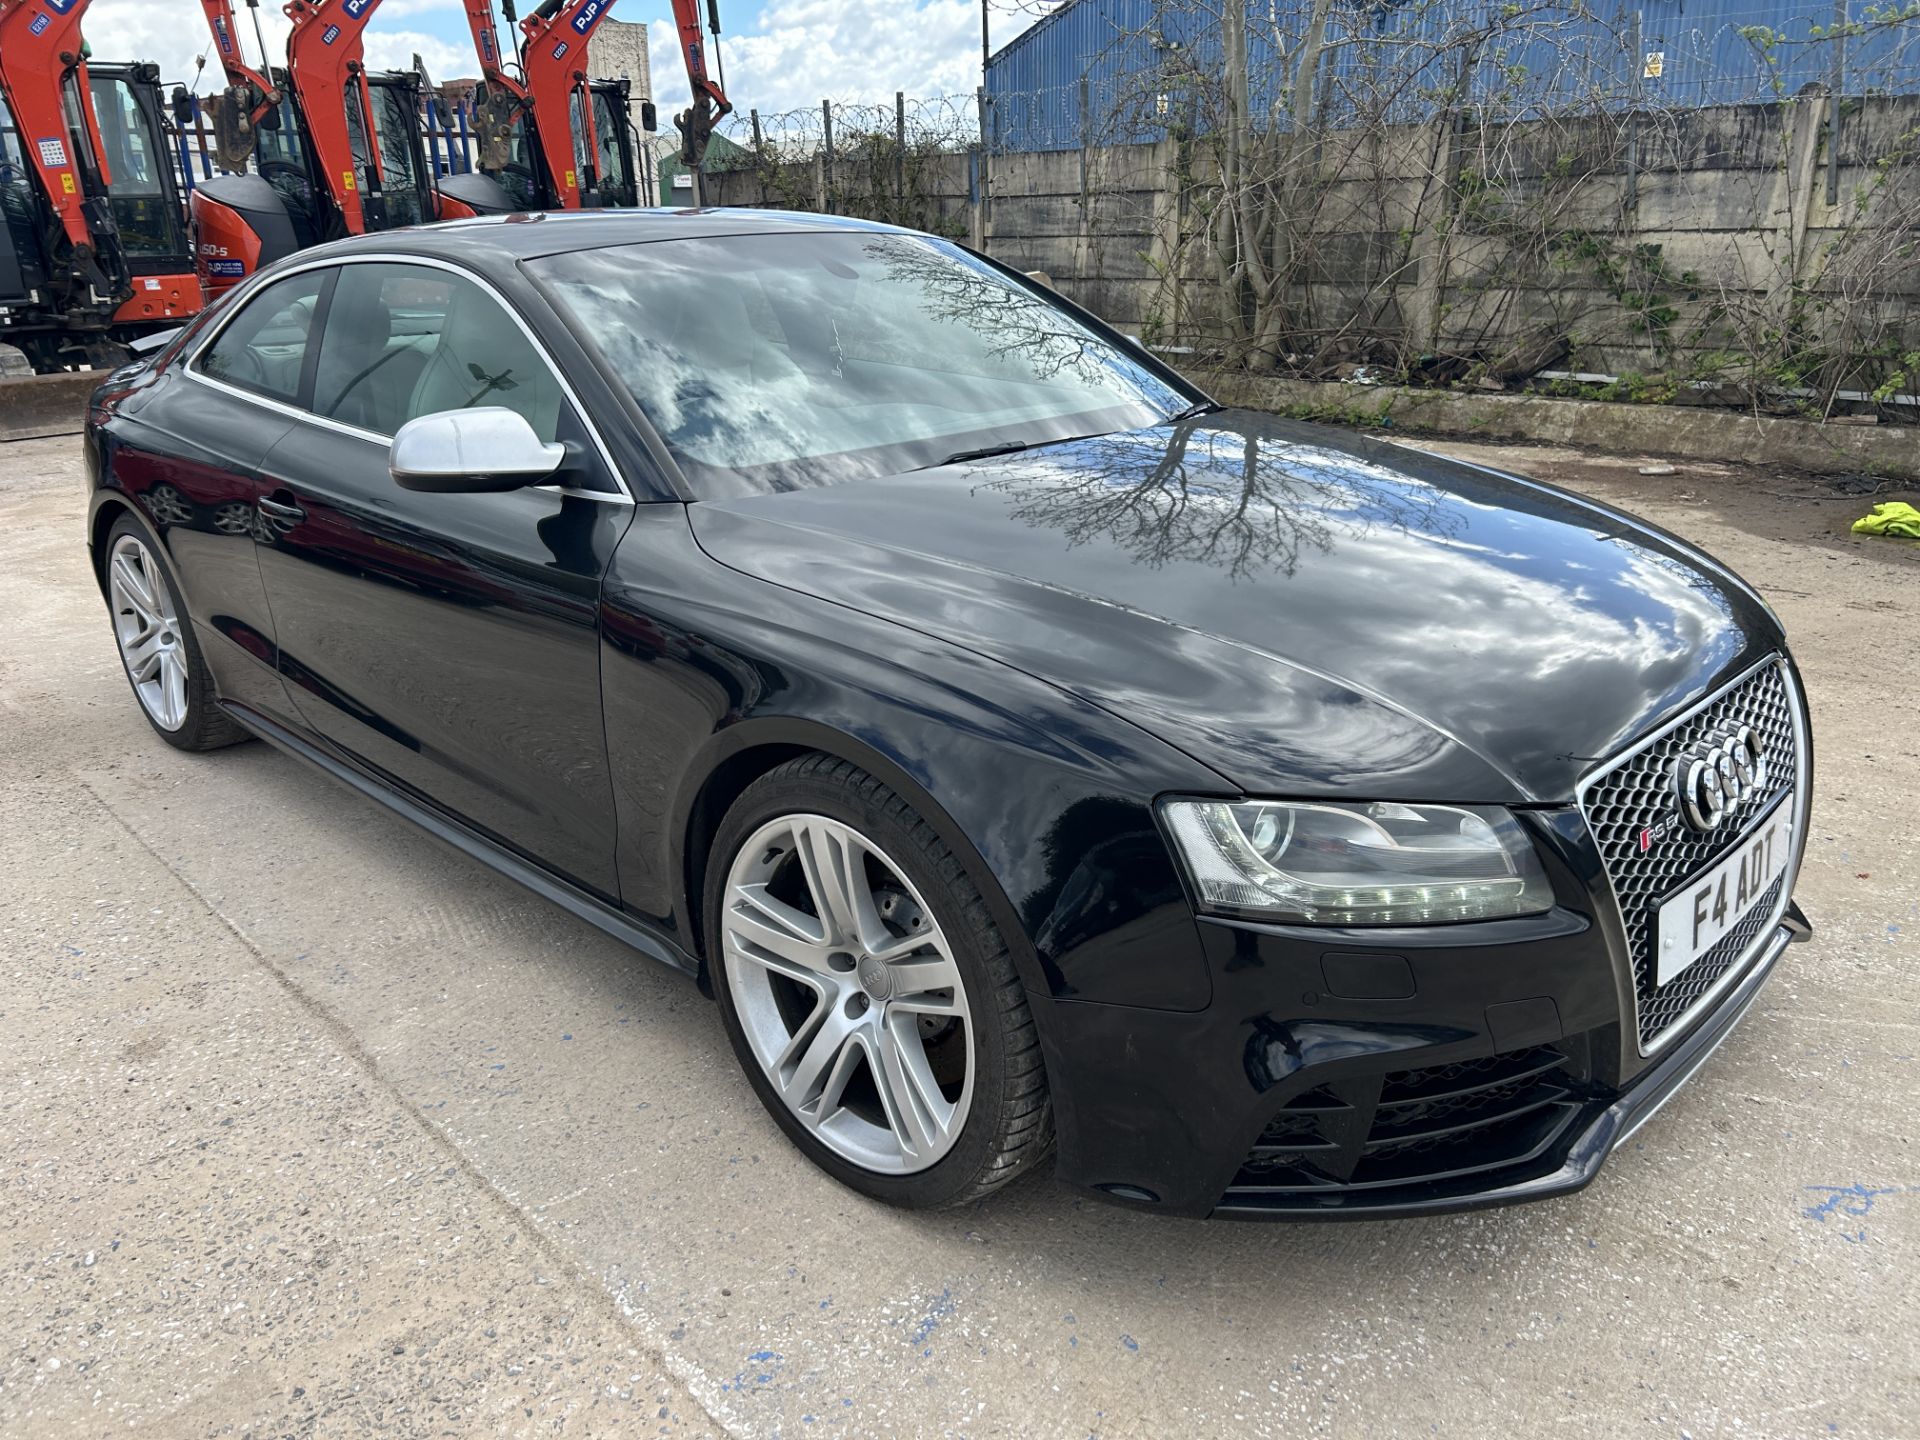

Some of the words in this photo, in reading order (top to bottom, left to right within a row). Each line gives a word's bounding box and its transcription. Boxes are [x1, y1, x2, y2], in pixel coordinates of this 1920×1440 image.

[575, 2, 598, 30] PJP
[1692, 871, 1728, 951] F4
[1734, 824, 1776, 914] ADT
